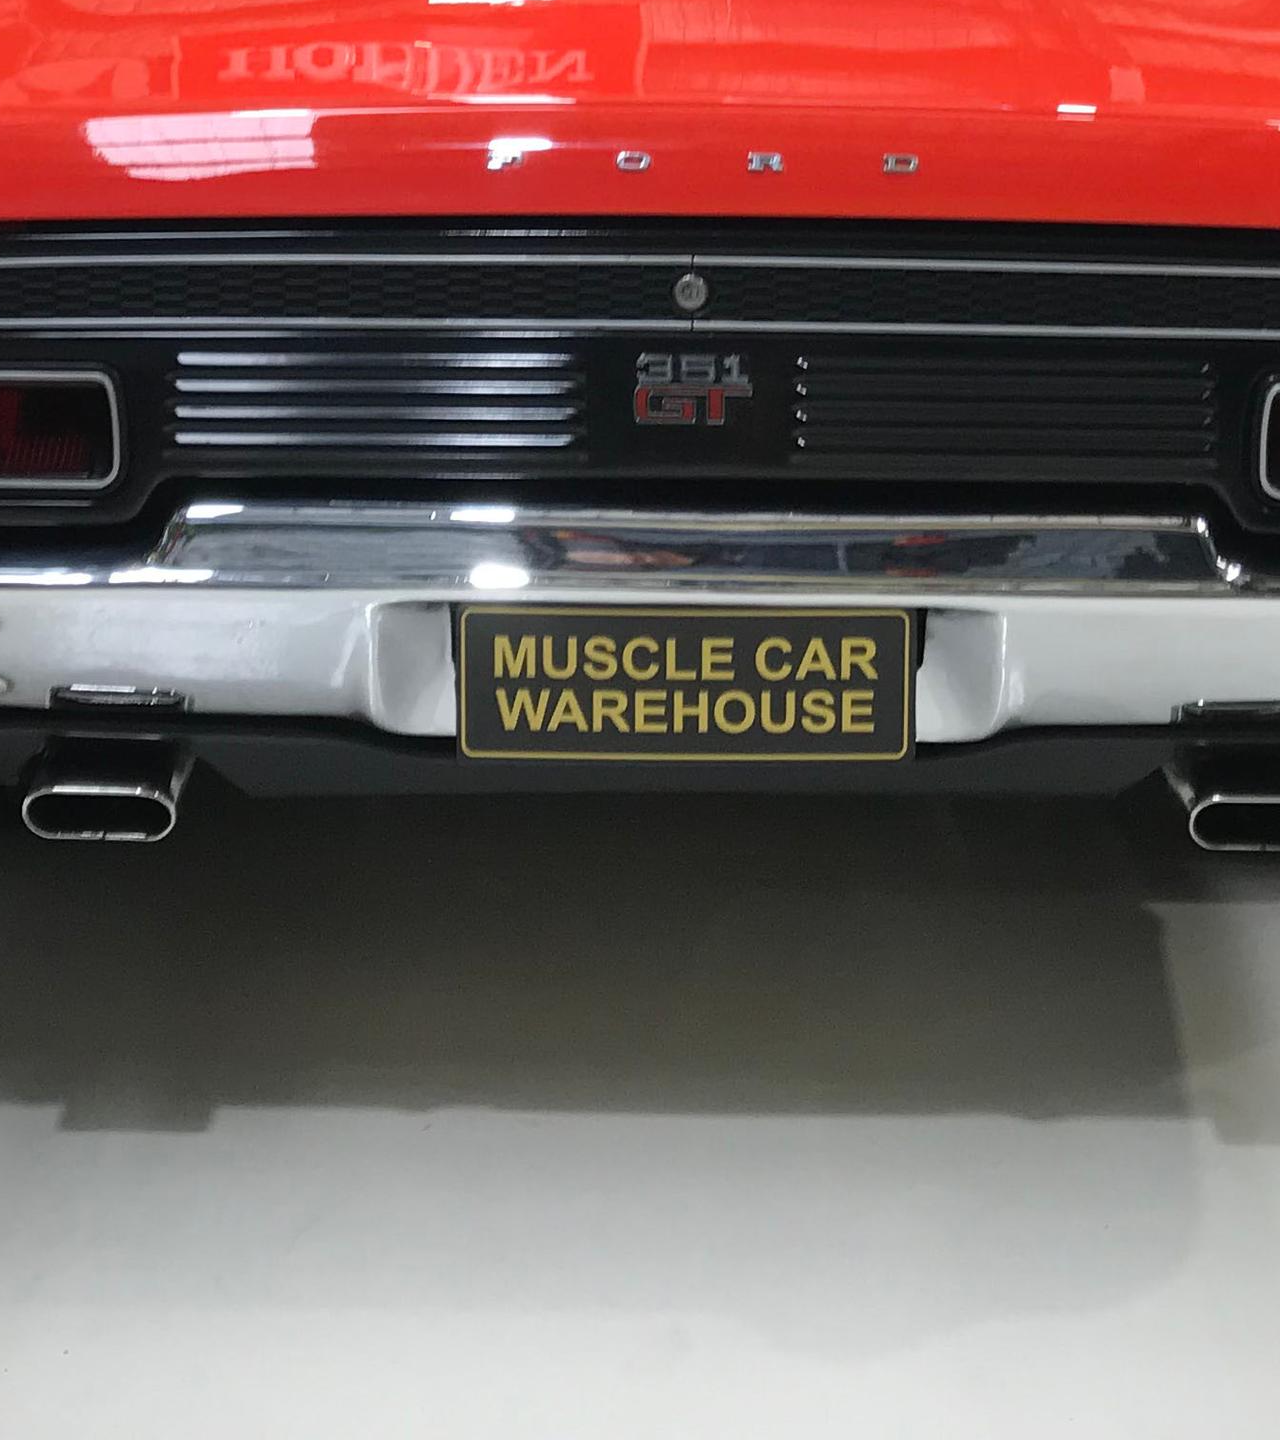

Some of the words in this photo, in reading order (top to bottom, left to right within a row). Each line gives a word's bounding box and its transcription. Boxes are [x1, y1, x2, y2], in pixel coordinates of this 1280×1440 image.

[487, 147, 919, 172] FORD
[635, 353, 752, 383] 351
[635, 383, 754, 426] GT
[493, 635, 735, 682] MUSCLE
[754, 637, 878, 682] CAR
[496, 688, 875, 734] WAREHOUSE
